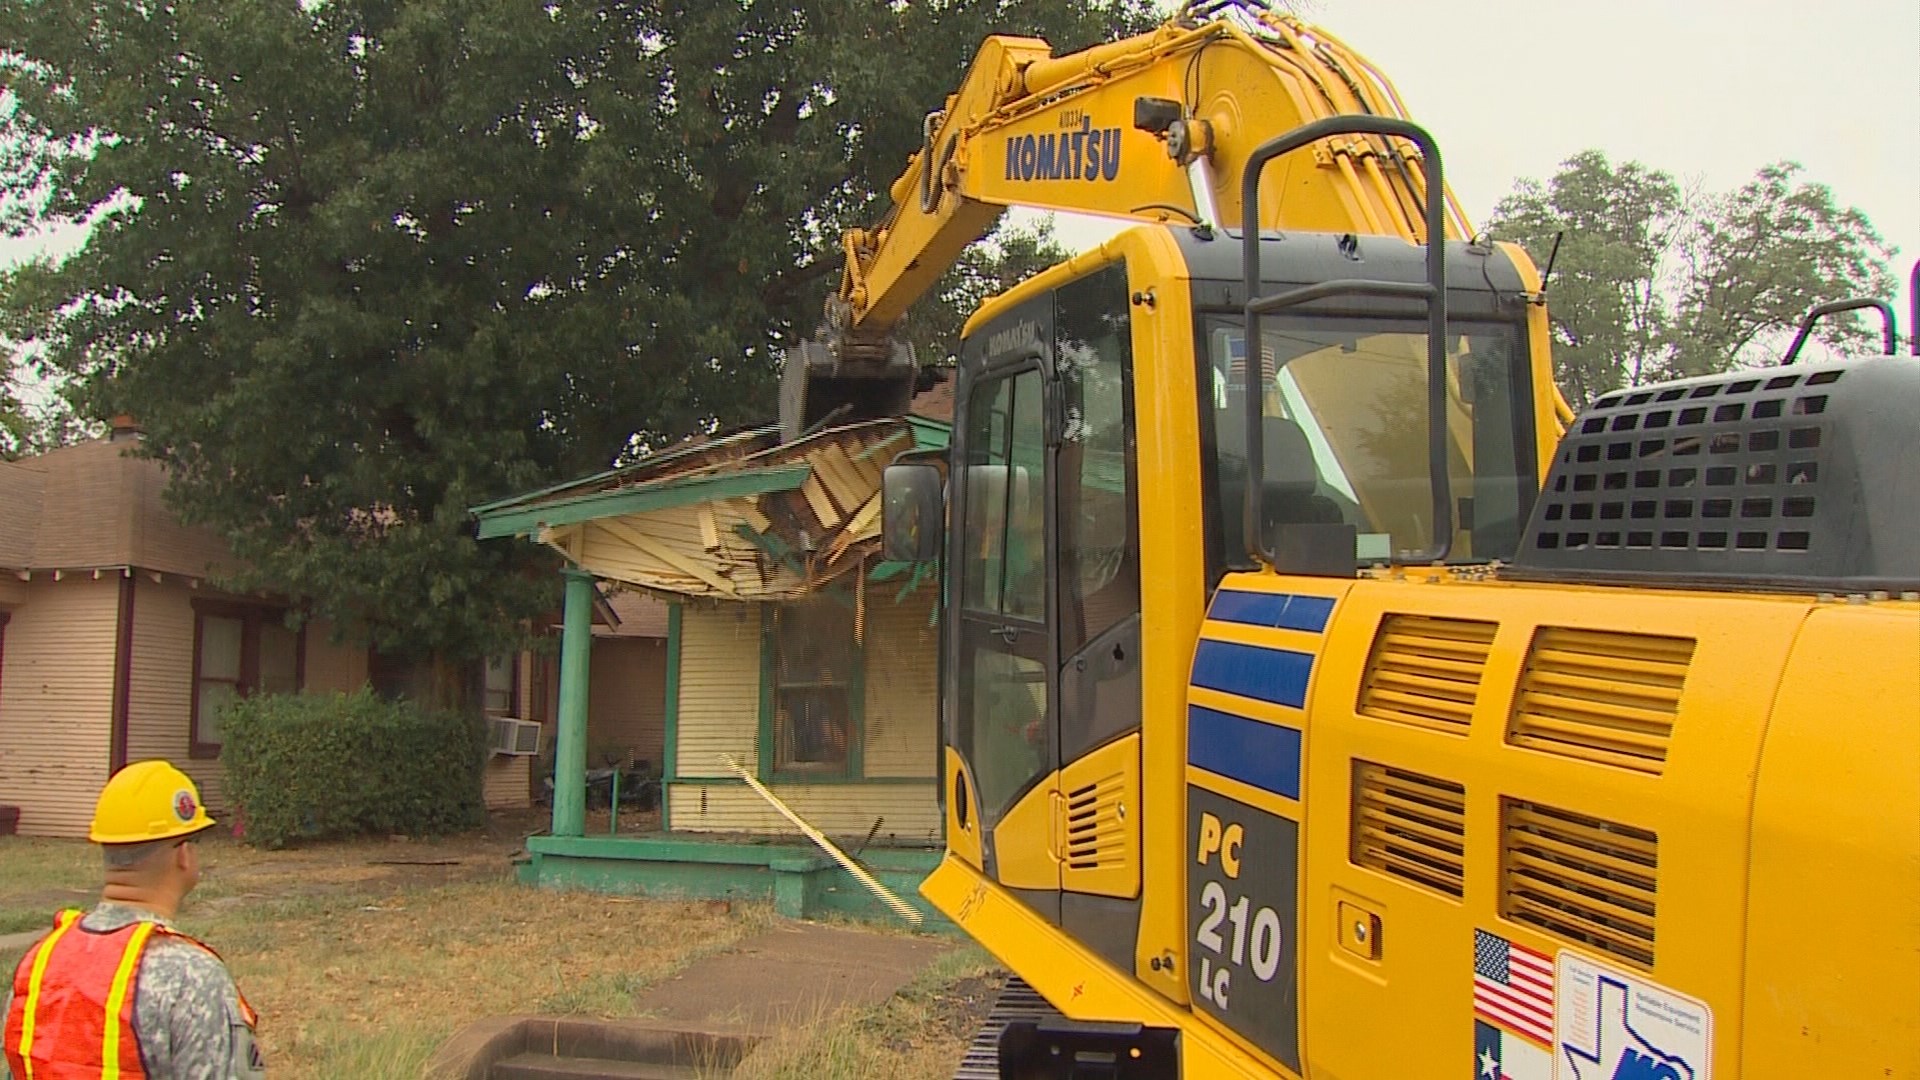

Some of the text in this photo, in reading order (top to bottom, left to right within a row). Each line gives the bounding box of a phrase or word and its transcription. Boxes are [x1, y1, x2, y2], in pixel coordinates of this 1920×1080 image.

[1005, 115, 1121, 181] KOMATSU
[988, 318, 1035, 357] KOMATSU
[1197, 811, 1244, 879] PC
[1196, 881, 1282, 982] 210
[1200, 957, 1231, 1011] LC
